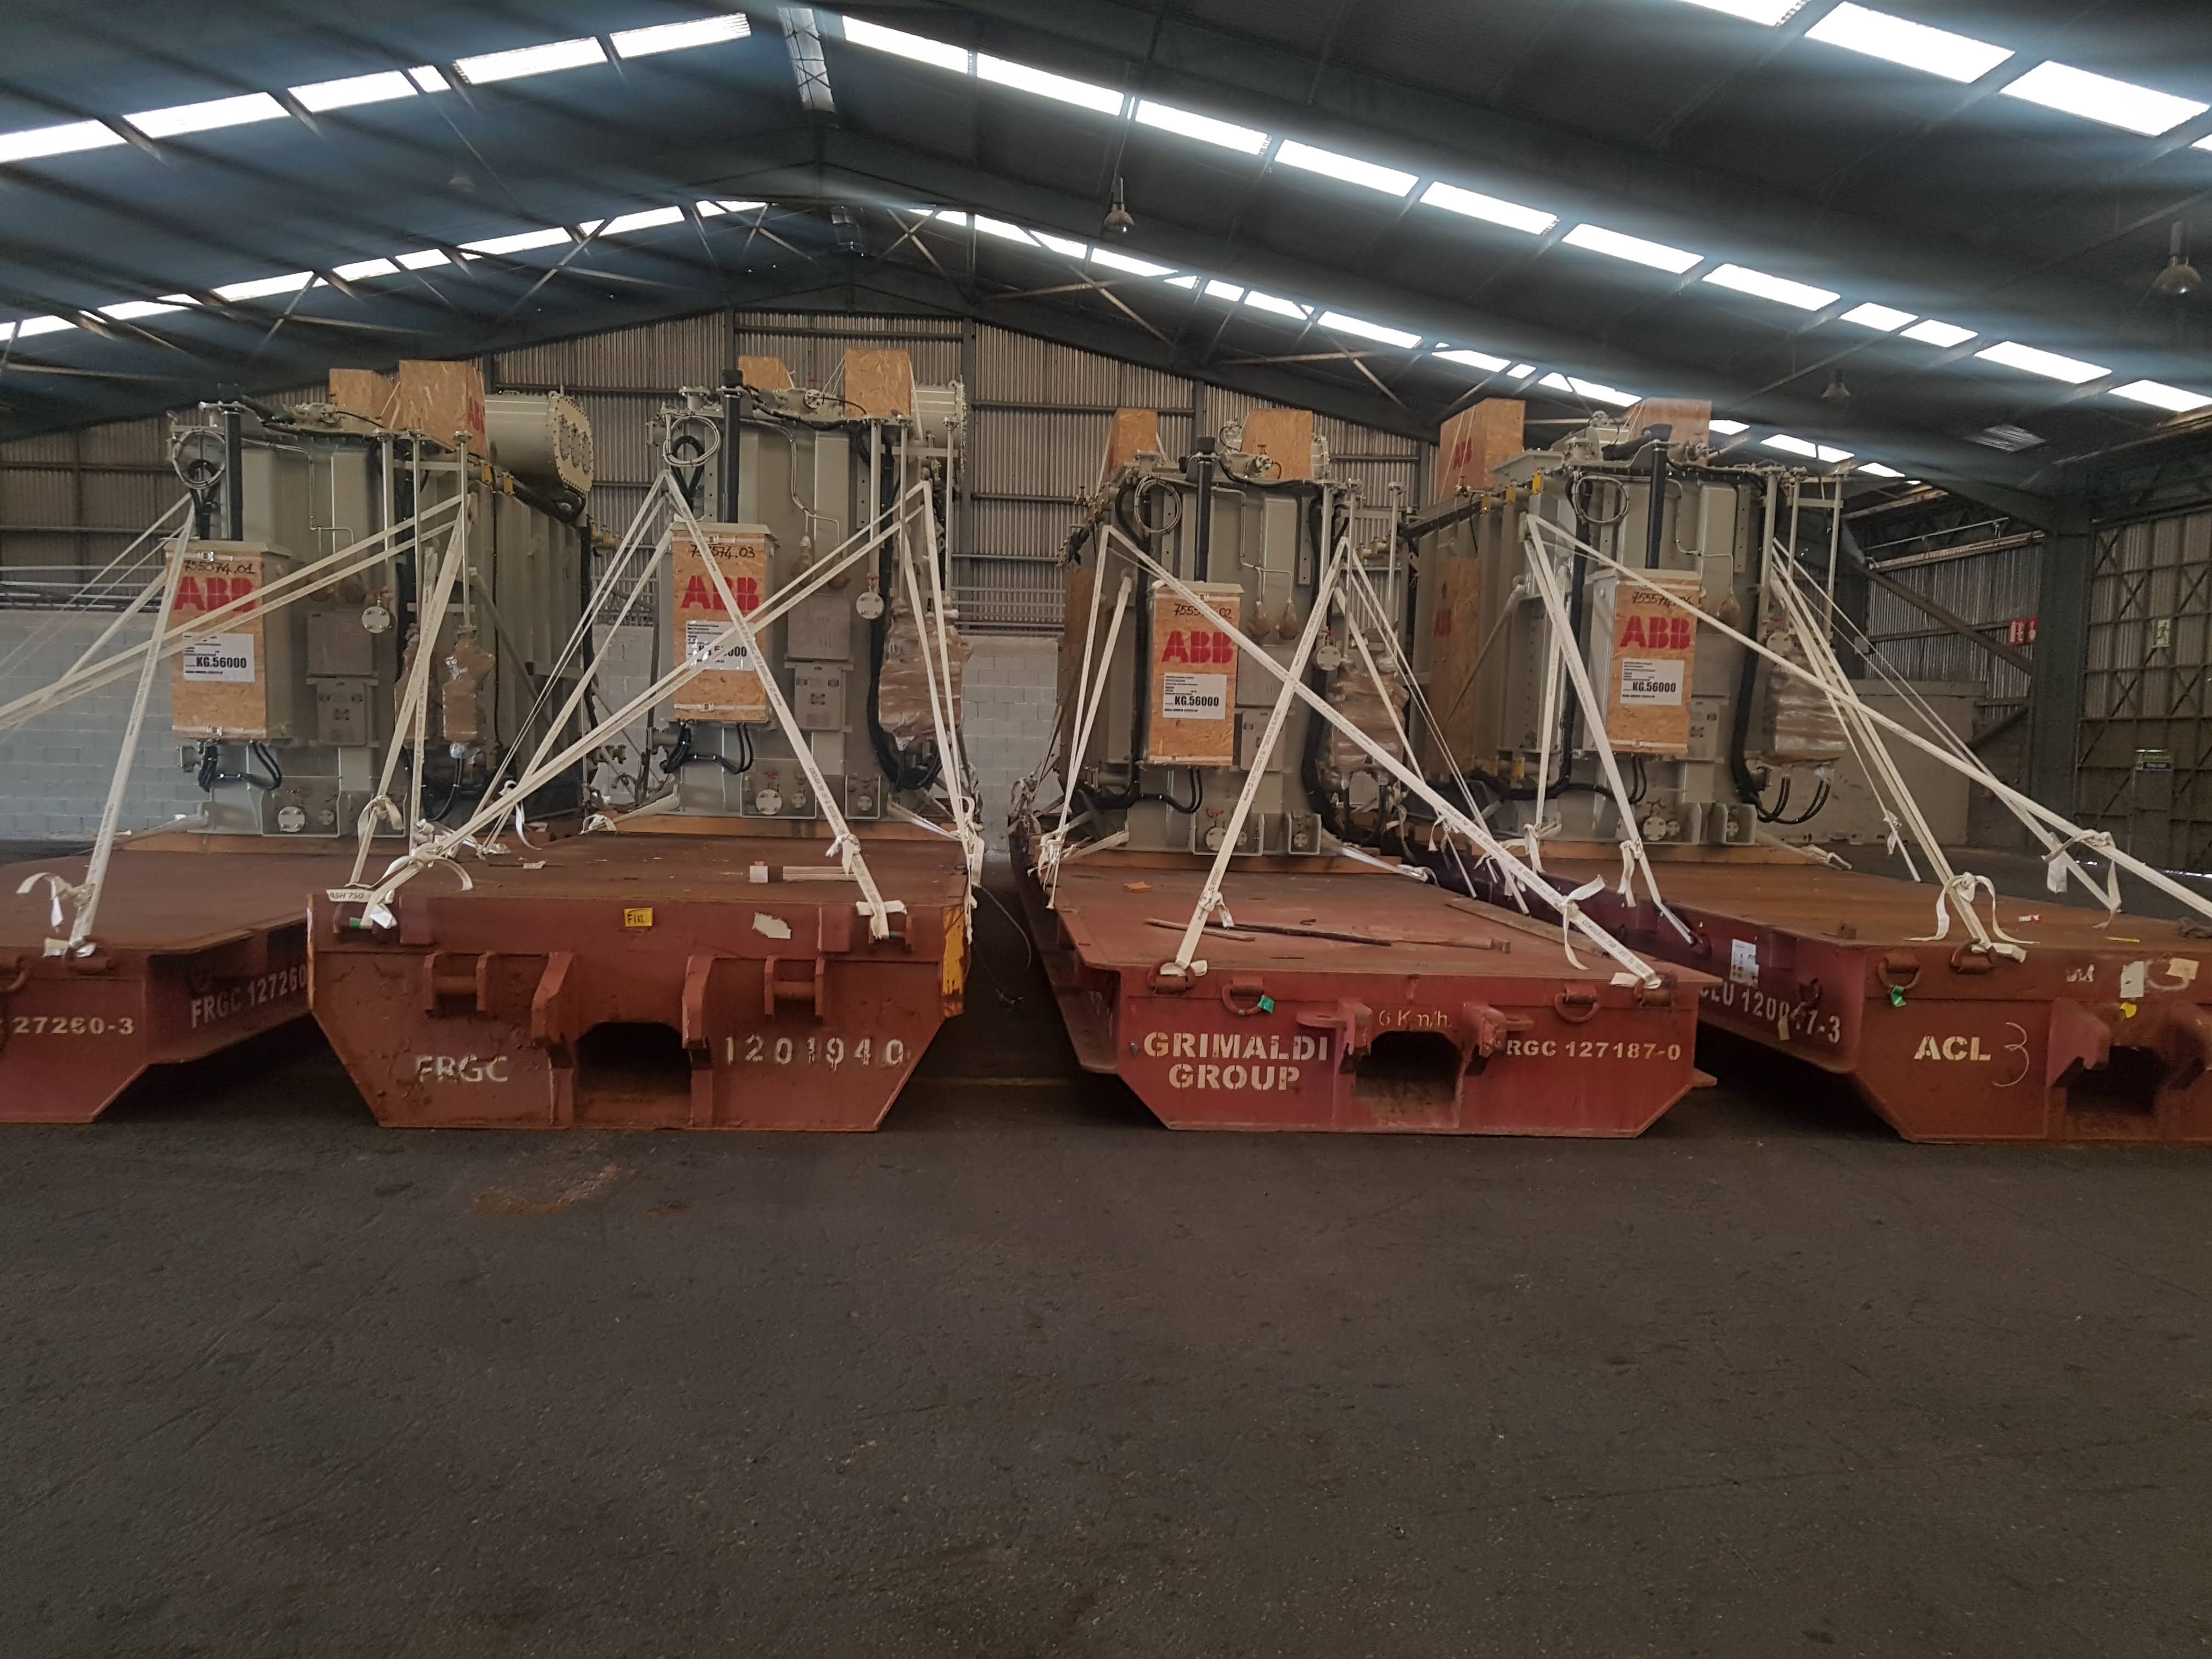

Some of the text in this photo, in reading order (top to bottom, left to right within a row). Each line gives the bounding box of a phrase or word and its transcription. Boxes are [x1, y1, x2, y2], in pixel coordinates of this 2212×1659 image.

[690, 544, 755, 560] 7574.03
[174, 576, 256, 612] ABB
[681, 575, 760, 611] ABB
[1620, 616, 1691, 650] ABB
[1161, 631, 1234, 664] ABB
[196, 656, 247, 668] KG.56000
[1632, 681, 1677, 693] KG.56000
[1175, 696, 1219, 707] KG.56000
[1, 1016, 135, 1035] 27260-3
[1144, 1032, 1328, 1060] GRIMALDI
[1497, 1039, 1681, 1060] RGC 127187-0
[1914, 1036, 1991, 1061] ACL
[415, 1054, 509, 1082] FRGC
[1169, 1063, 1299, 1090] GROUP
